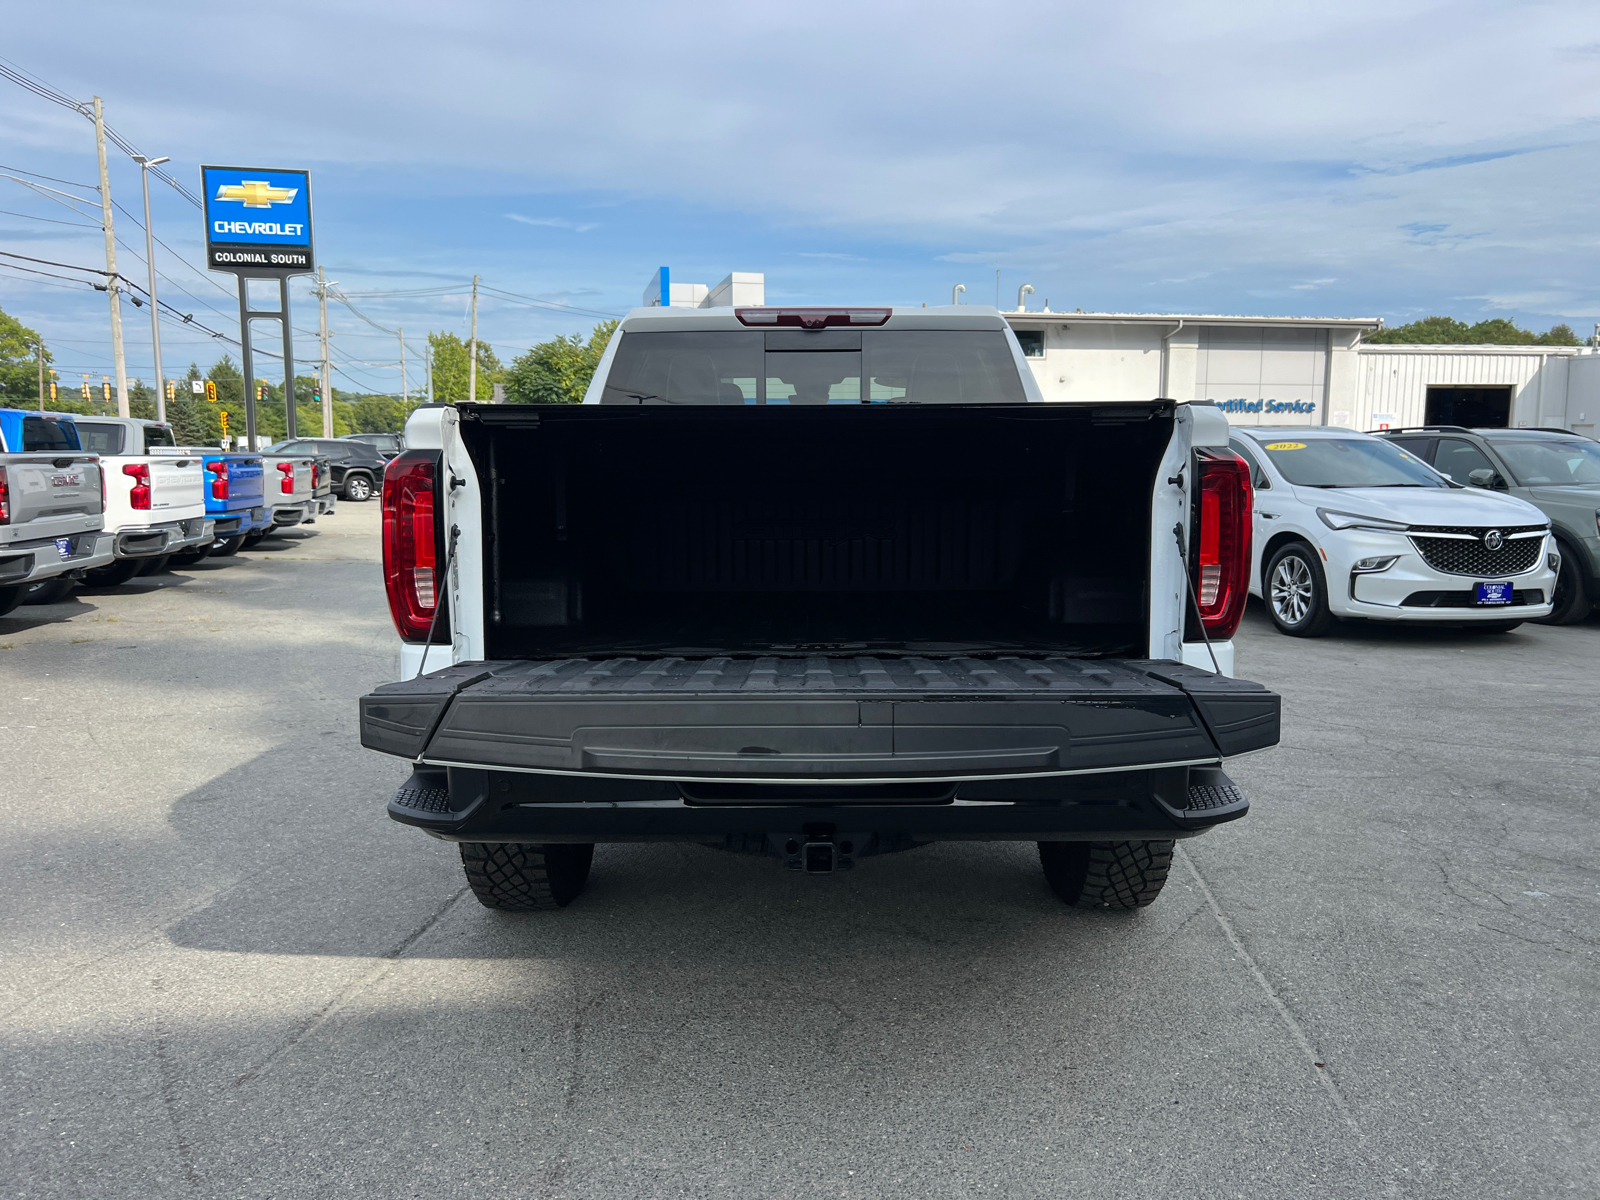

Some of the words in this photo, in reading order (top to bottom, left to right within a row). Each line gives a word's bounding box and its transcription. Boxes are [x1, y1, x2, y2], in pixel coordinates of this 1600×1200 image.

[214, 221, 303, 235] CHEVROLET
[215, 252, 268, 263] COLONIAL
[271, 254, 306, 265] SOUTH
[1266, 399, 1316, 413] Service
[51, 474, 80, 488] GMC
